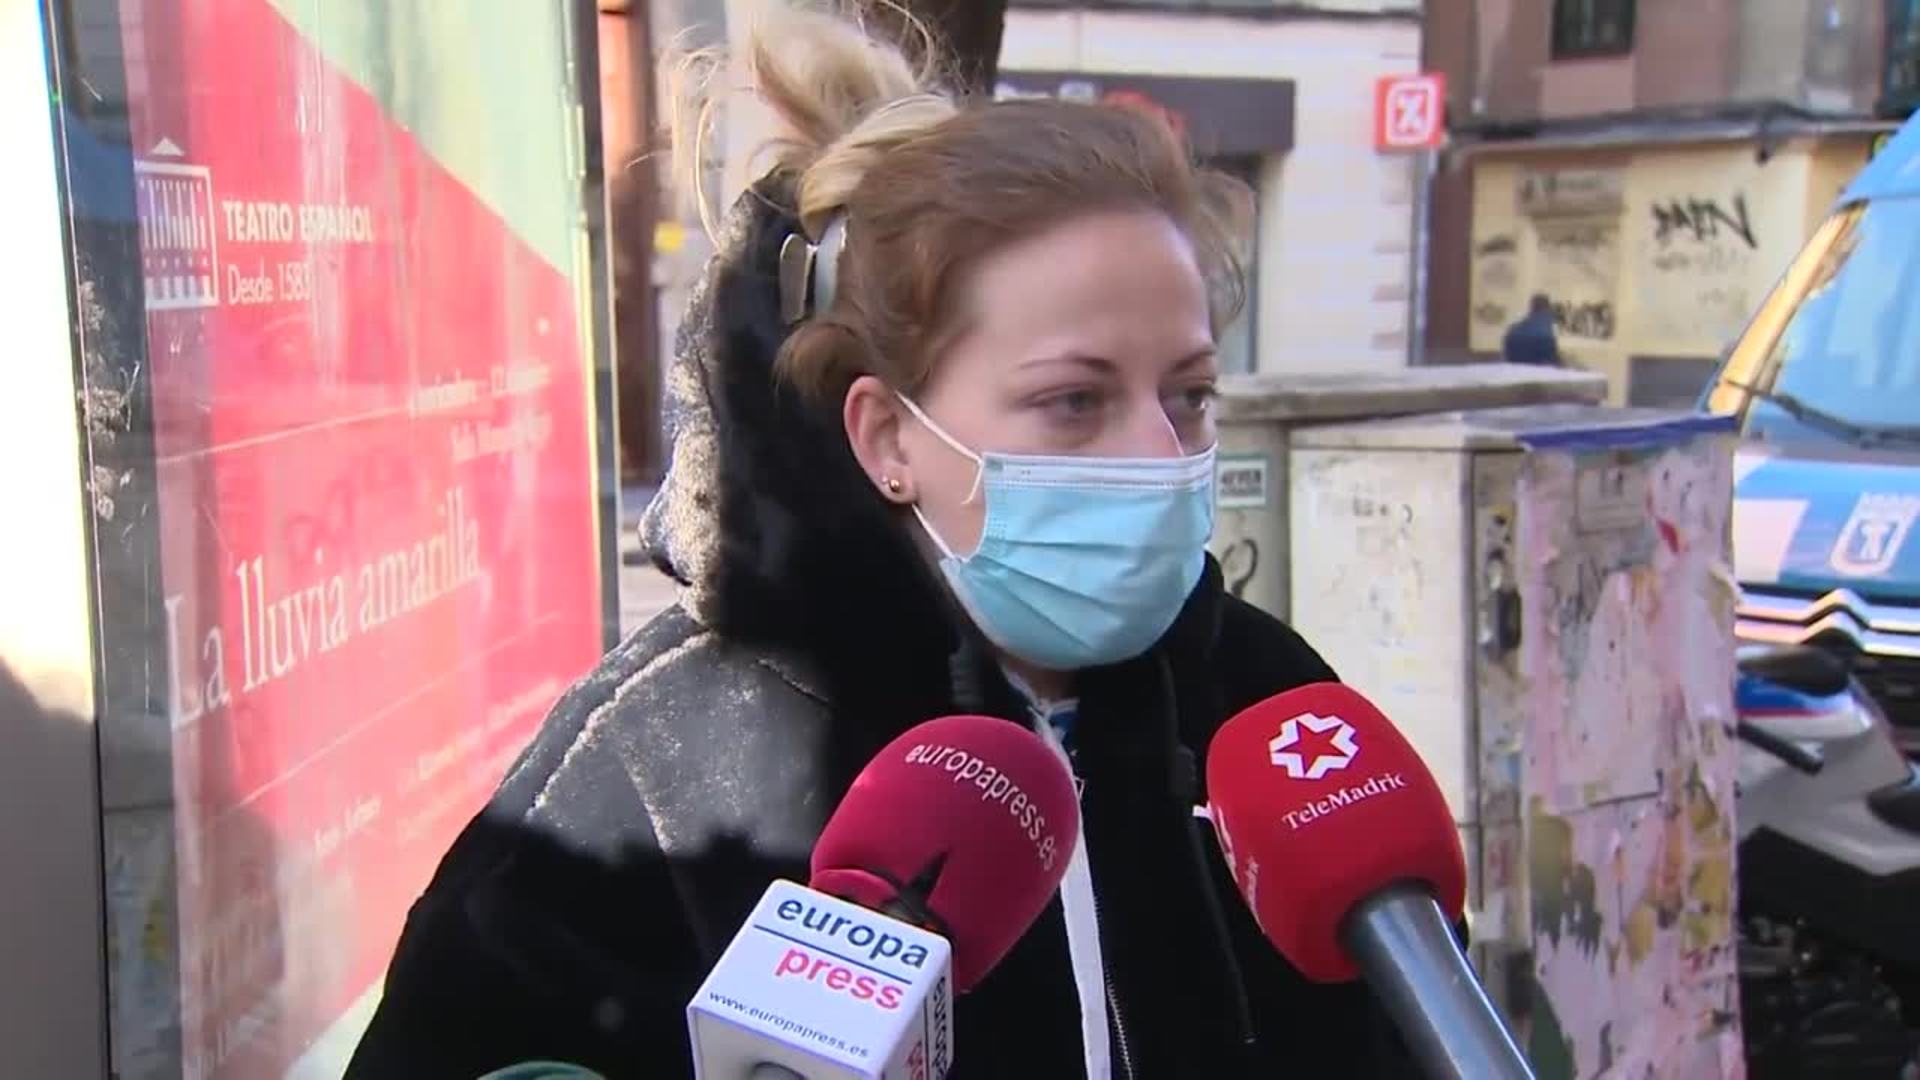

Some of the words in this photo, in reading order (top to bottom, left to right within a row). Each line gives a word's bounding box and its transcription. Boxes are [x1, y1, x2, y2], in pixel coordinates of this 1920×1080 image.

[221, 200, 294, 242] TEATRO
[299, 199, 373, 243] ESPAÑOL
[227, 256, 274, 304] Desde
[163, 594, 232, 731] La
[235, 547, 349, 693] lluvia
[357, 487, 481, 631] amarilla
[905, 741, 1058, 870] europapress.es
[776, 897, 929, 970] europa
[774, 946, 904, 1011] press
[708, 989, 870, 1059] www.europapress.es
